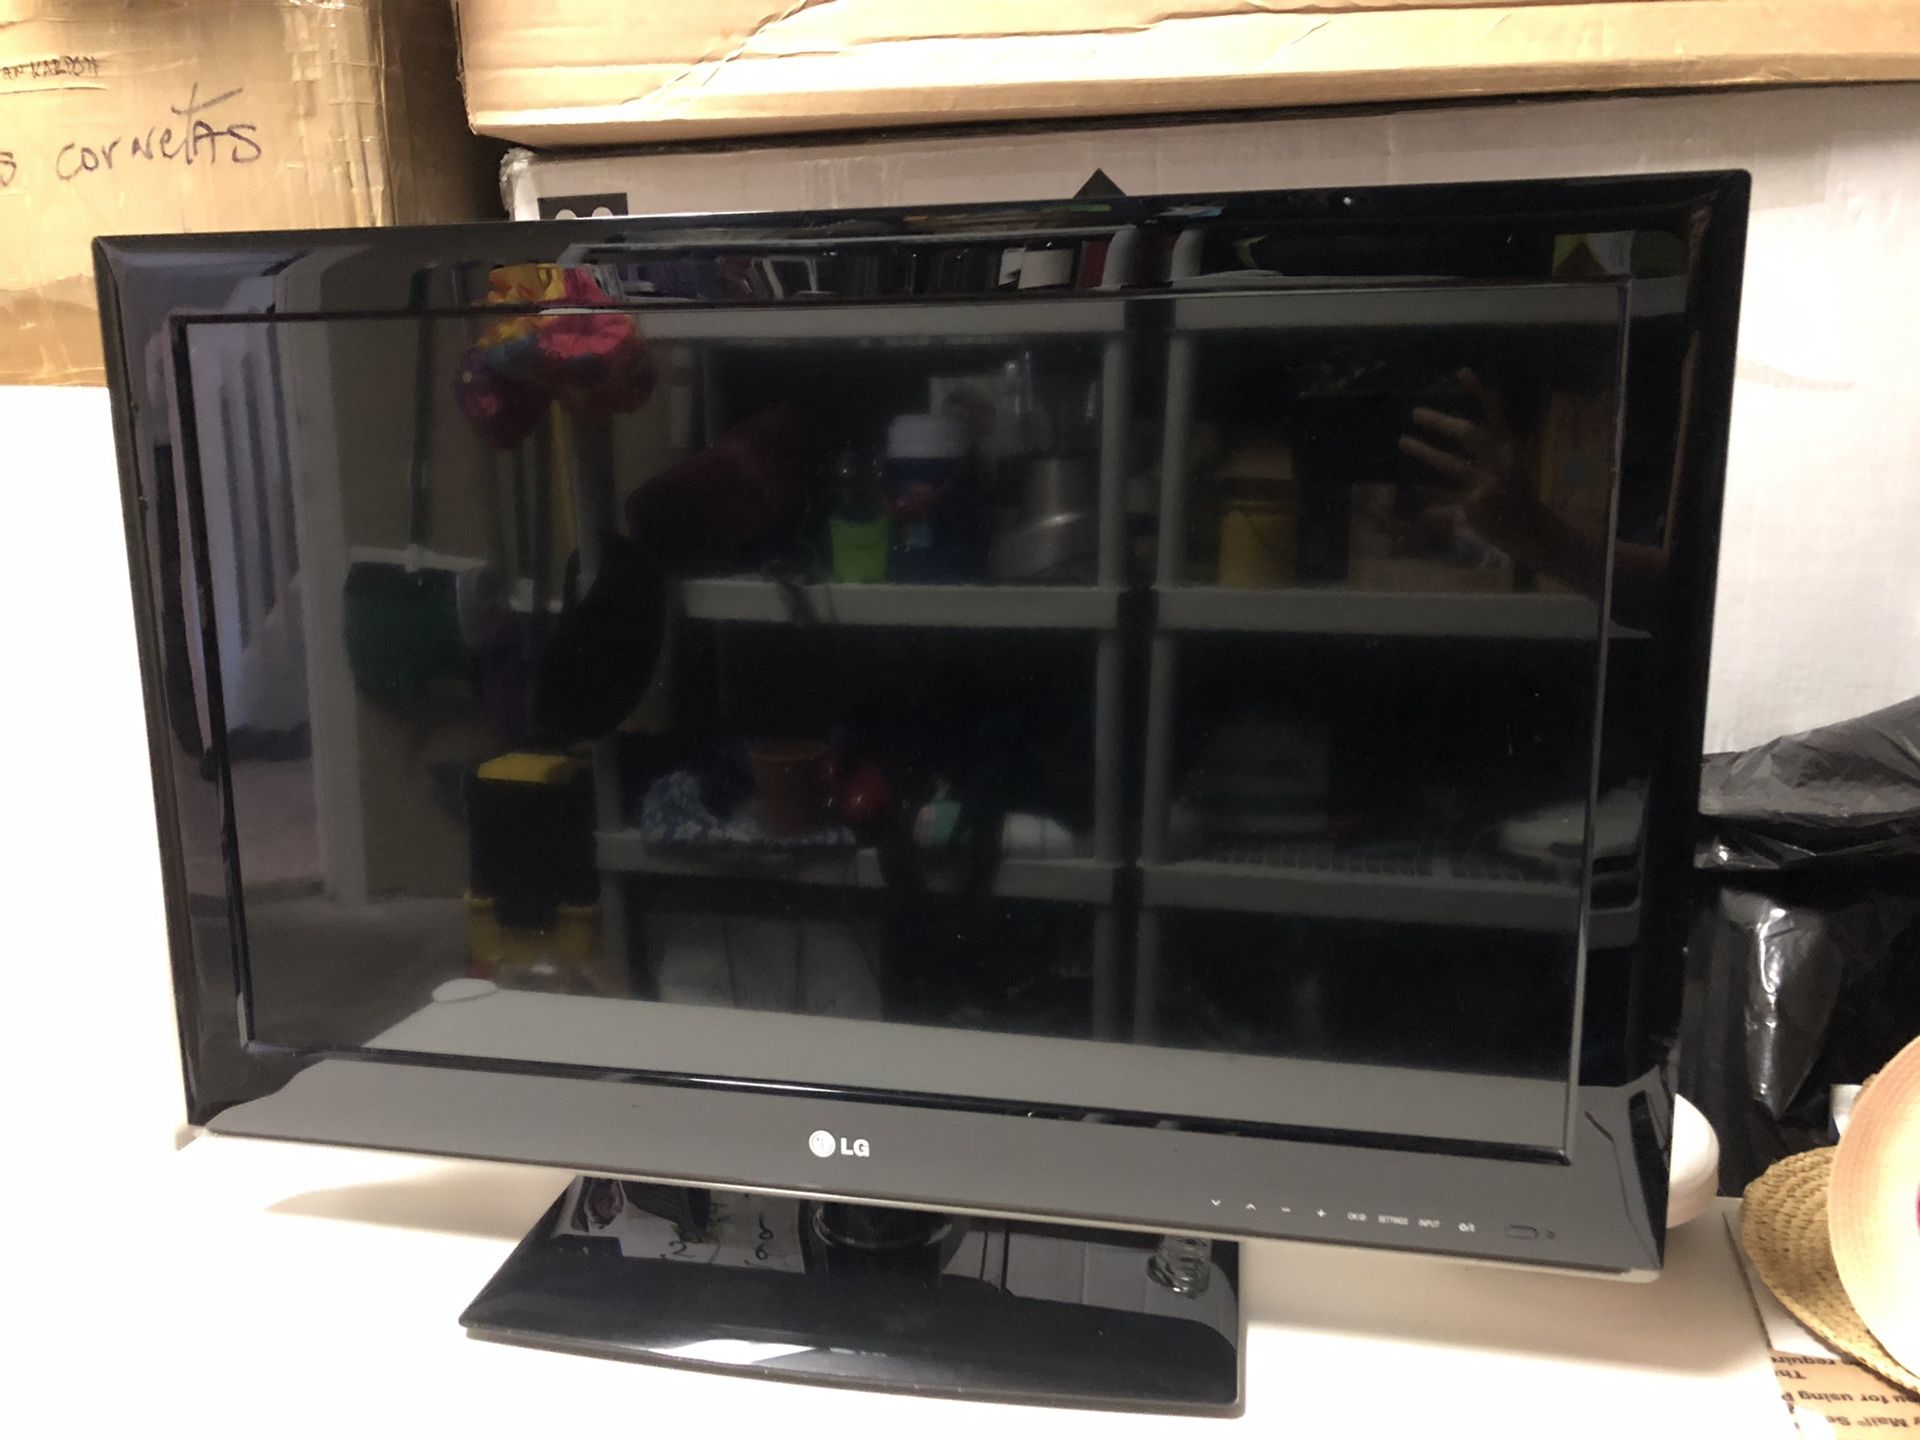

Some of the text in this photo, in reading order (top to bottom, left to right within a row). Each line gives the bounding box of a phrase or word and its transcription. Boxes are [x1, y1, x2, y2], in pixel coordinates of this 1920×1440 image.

[840, 1137, 869, 1157] LG
[1797, 1390, 1854, 1402] using
[1860, 1393, 1890, 1404] for
